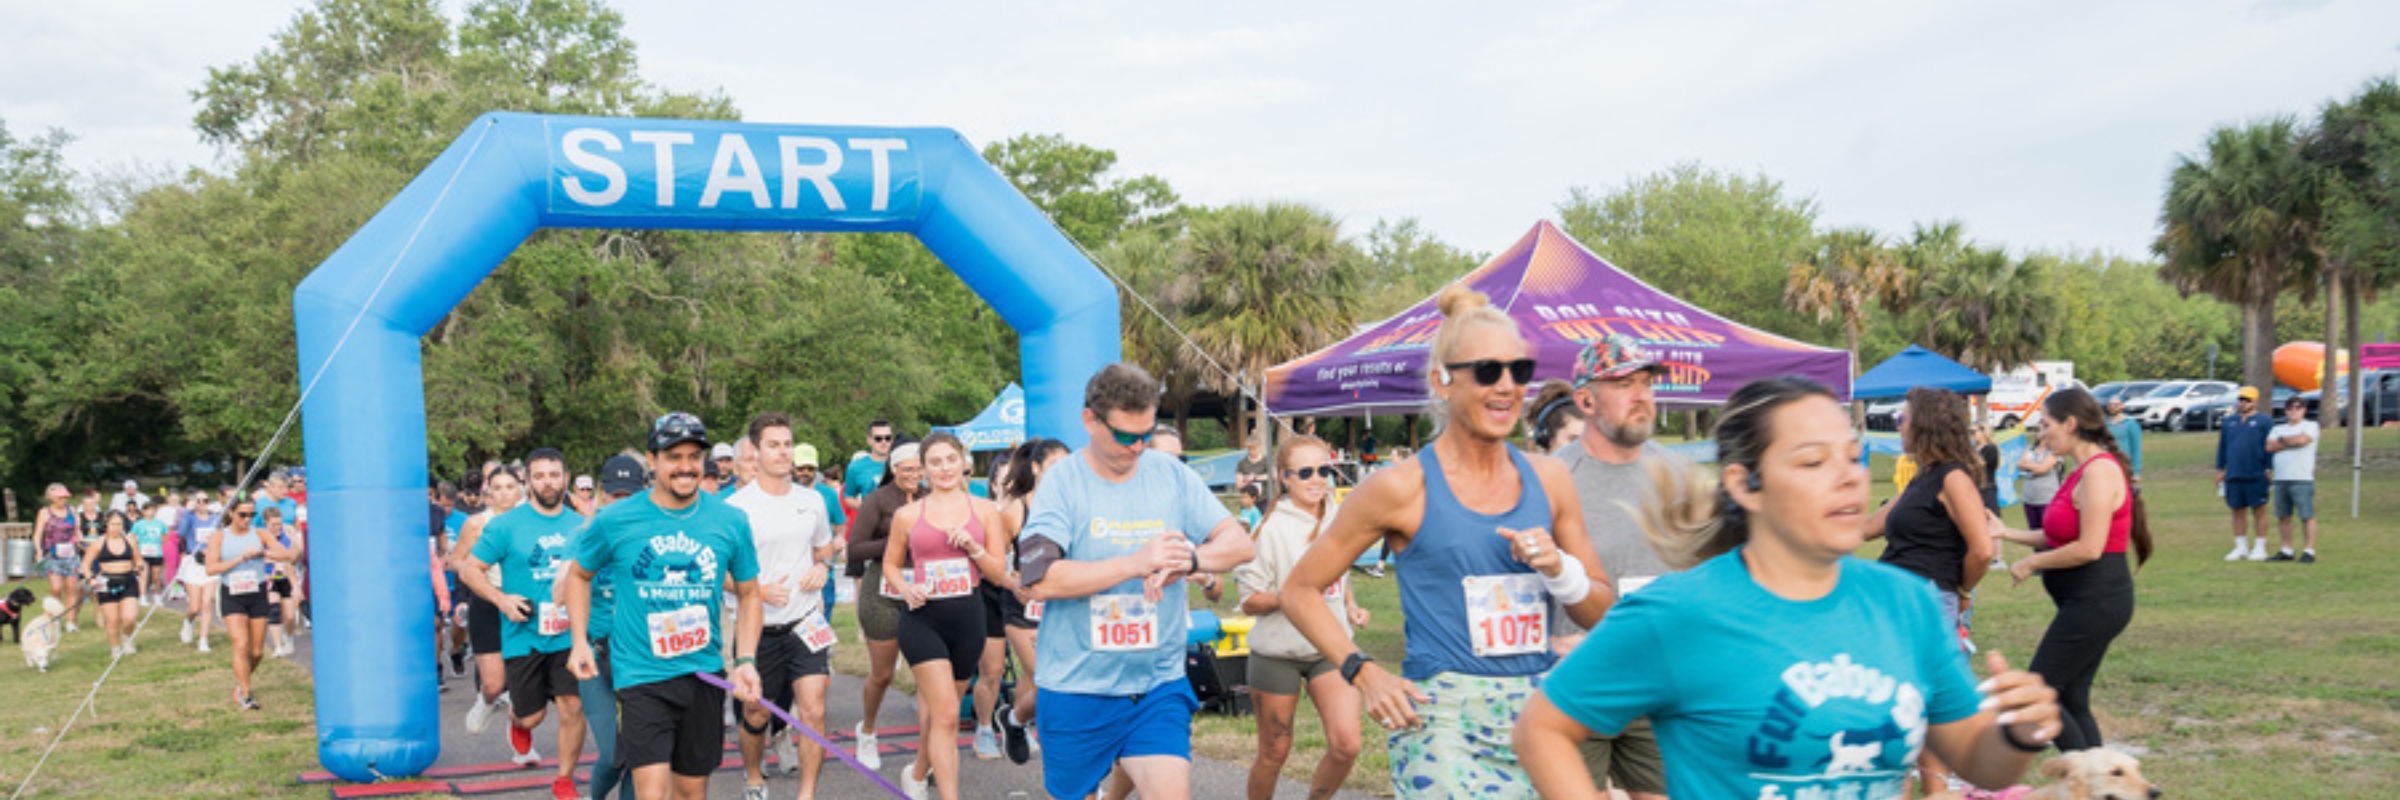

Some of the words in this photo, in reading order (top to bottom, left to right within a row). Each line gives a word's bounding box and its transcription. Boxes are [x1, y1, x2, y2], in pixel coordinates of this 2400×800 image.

[560, 127, 908, 212] START
[649, 530, 701, 555] Baby
[656, 627, 707, 654] 1052
[1098, 621, 1152, 645] 1051
[1479, 612, 1543, 648] 1075
[1781, 653, 1897, 708] Baby
